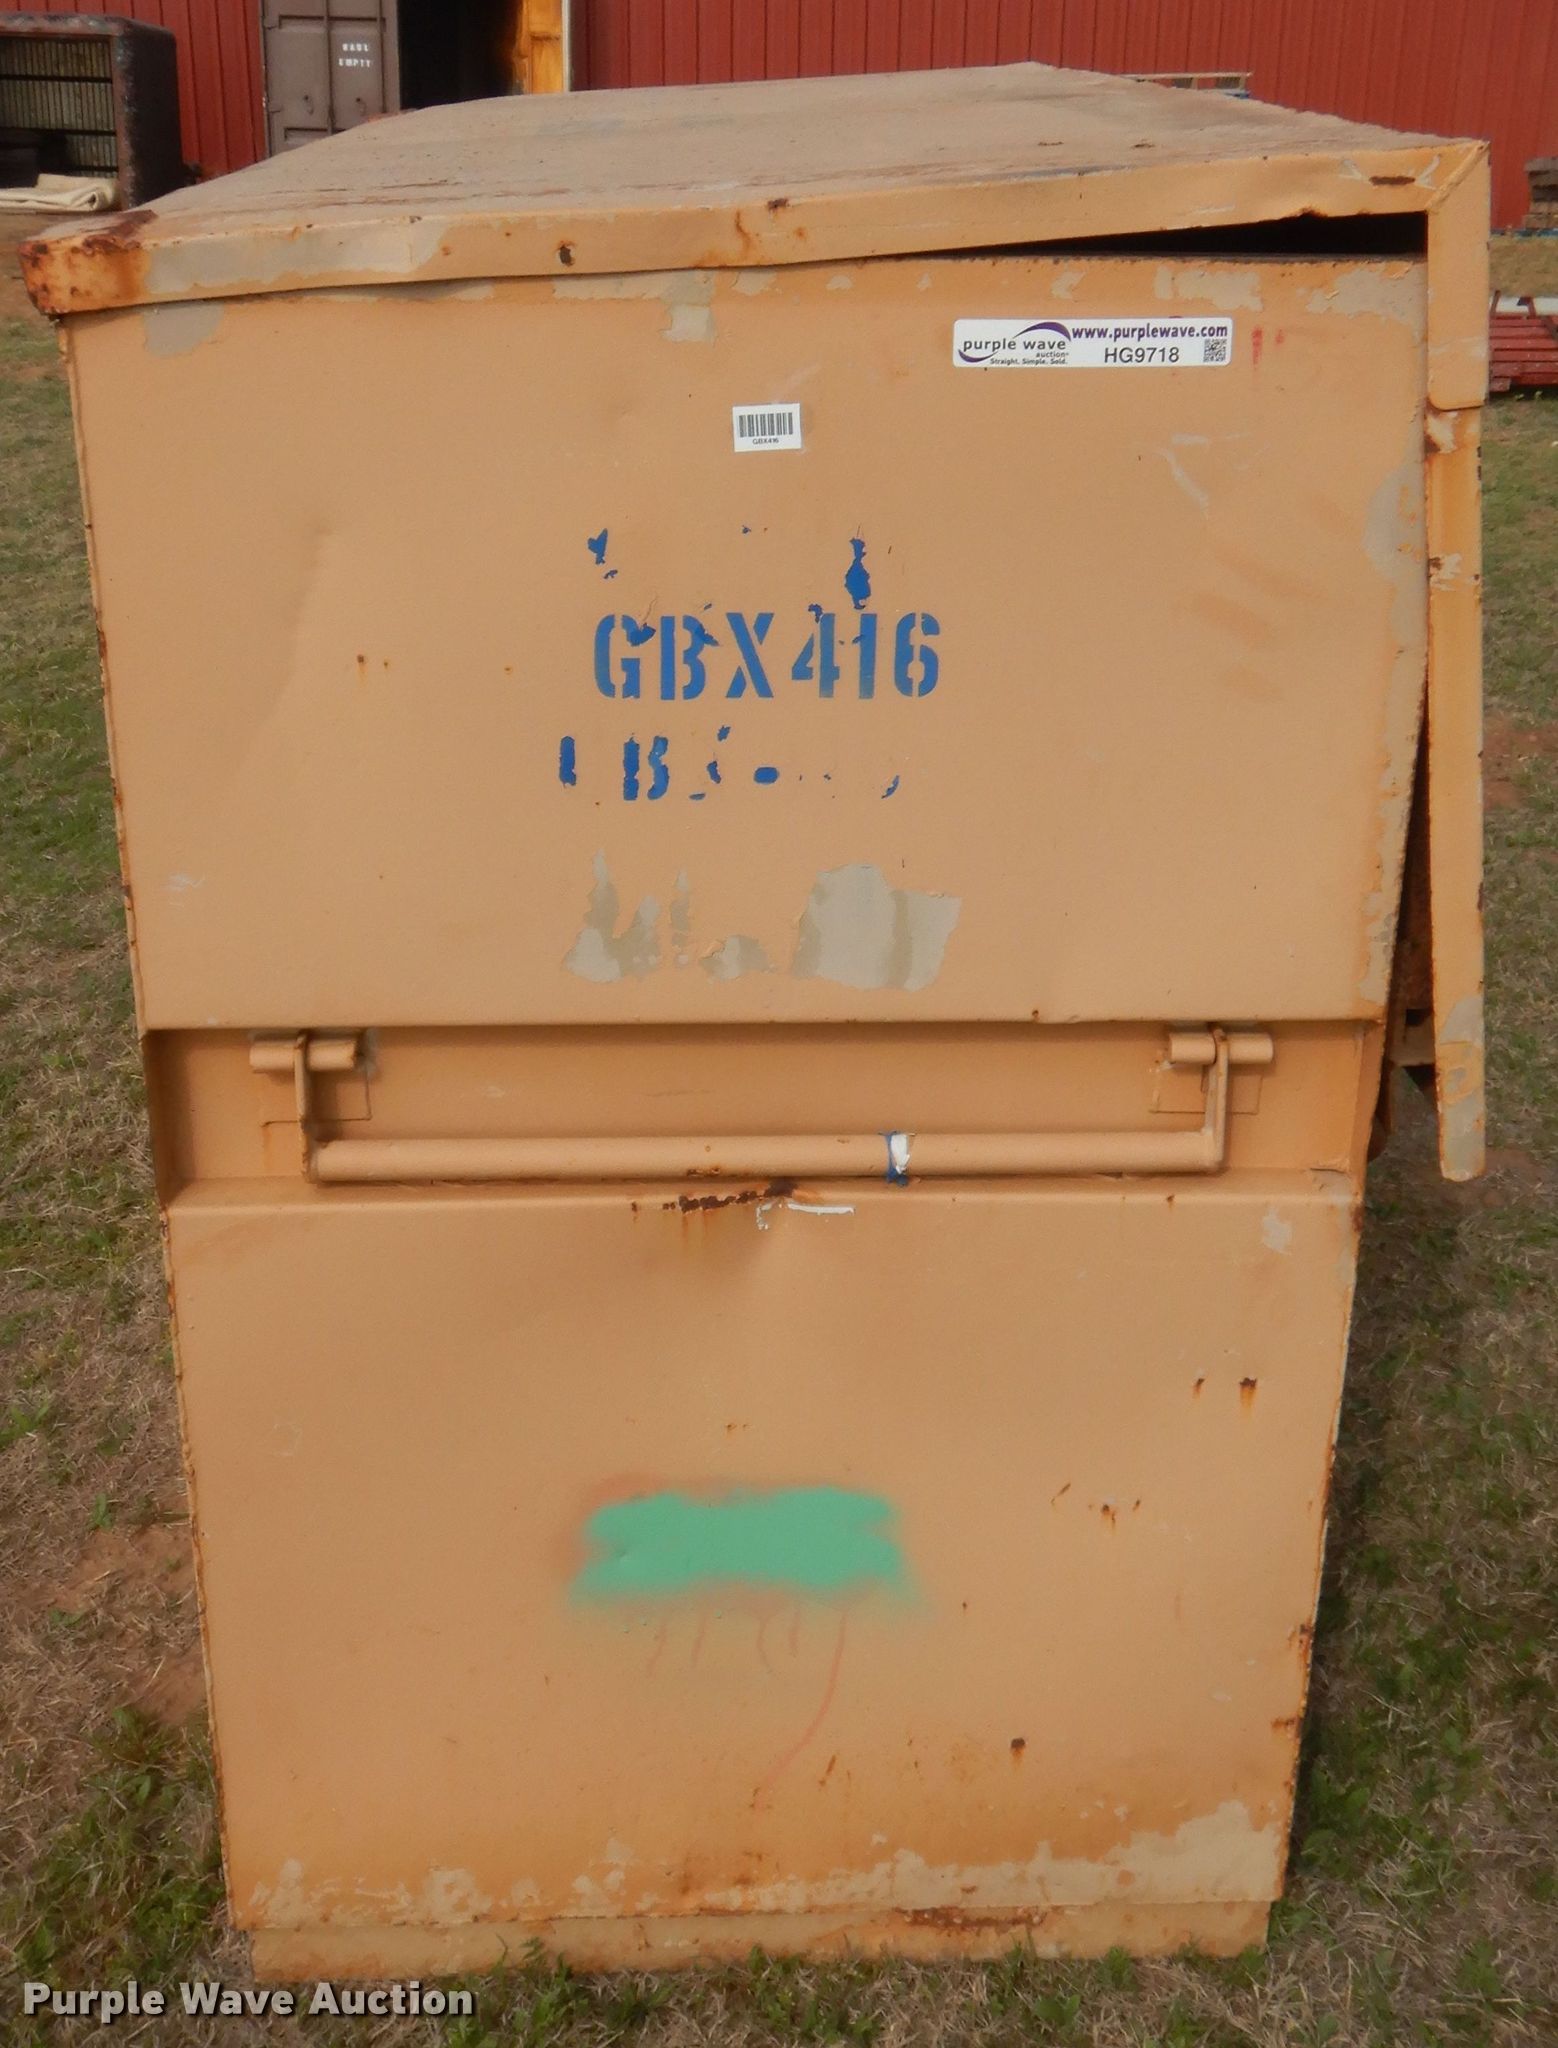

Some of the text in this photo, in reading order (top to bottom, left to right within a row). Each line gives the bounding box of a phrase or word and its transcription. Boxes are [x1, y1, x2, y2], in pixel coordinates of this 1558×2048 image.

[338, 58, 371, 68] EMPTY
[1072, 323, 1228, 342] www.purplewave.com
[963, 338, 1066, 352] purple wave
[990, 358, 1019, 366] Straight.
[1022, 358, 1048, 366] Simple.
[1104, 346, 1180, 364] HG9718
[752, 437, 779, 445] GBX416
[594, 611, 940, 700] GBX416
